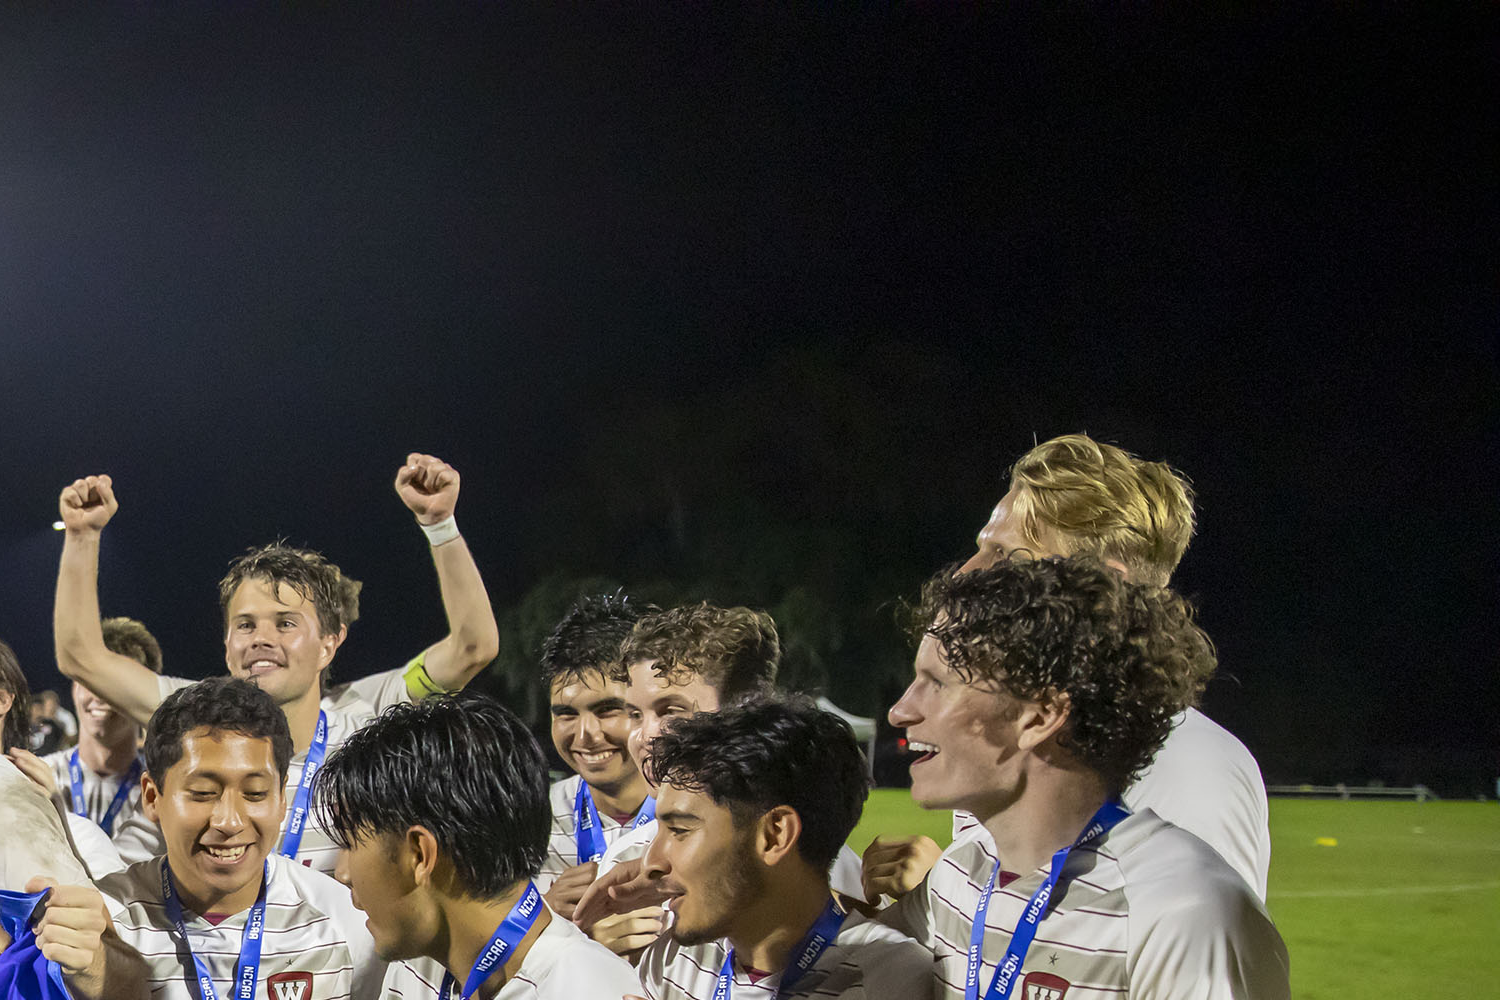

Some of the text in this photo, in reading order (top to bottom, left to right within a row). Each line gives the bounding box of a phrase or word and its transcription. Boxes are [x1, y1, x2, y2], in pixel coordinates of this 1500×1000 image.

[303, 761, 317, 788] NCCAA
[290, 807, 304, 834] NCCAA
[518, 888, 539, 918] NCCAA
[1025, 884, 1052, 925] NCCAA
[248, 908, 263, 941] NCCAA
[476, 938, 508, 972] NCCAA
[797, 934, 826, 970] NCCAA
[968, 944, 979, 987] NCCAA
[240, 965, 255, 999] NCCAA
[994, 953, 1020, 995] NCCAA
